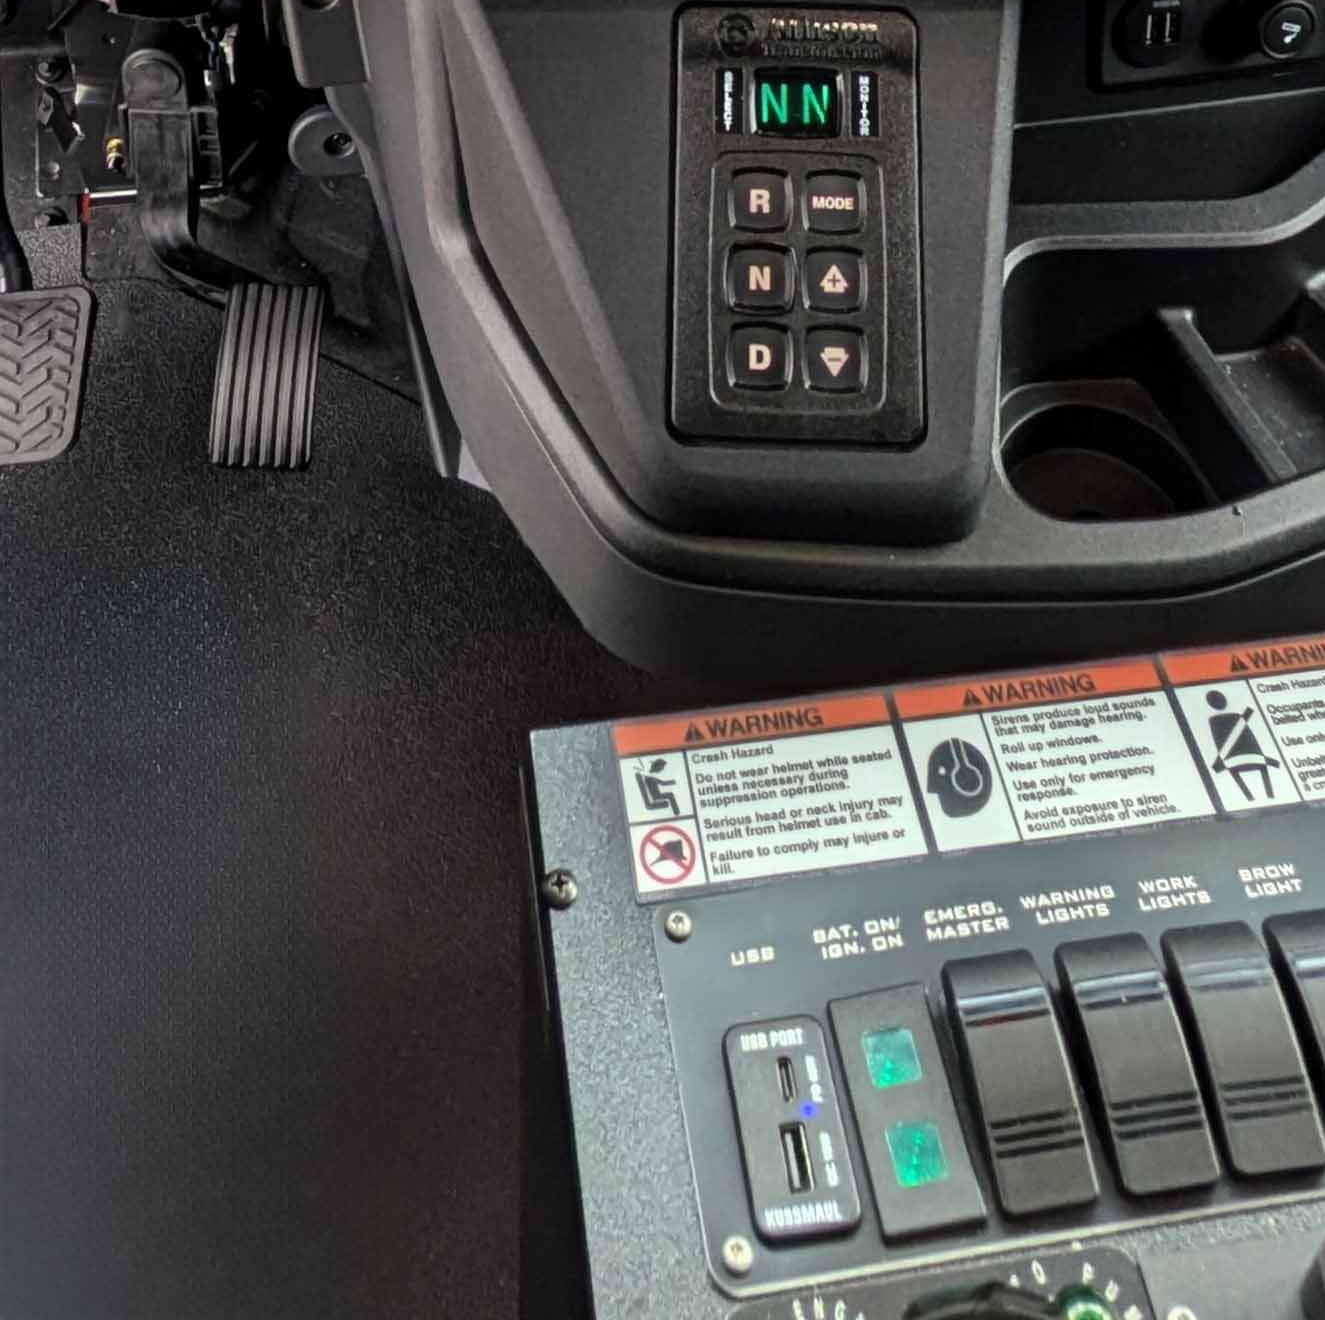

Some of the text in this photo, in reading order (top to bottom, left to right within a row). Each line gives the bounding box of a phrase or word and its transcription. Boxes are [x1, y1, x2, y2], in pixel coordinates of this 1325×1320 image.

[761, 83, 829, 124] N N
[859, 76, 870, 136] MONITOR
[750, 189, 771, 213] R
[812, 196, 854, 210] MODE
[749, 266, 771, 291] N
[748, 344, 771, 370] D
[982, 674, 1096, 706] WARNING
[706, 708, 823, 739] WARNING
[991, 697, 1155, 726] Sirens produce loud sounds
[1281, 734, 1304, 747] Use
[692, 744, 774, 765] Crash Hazard
[695, 749, 892, 784] Do not wear helmet while seated
[1006, 745, 1154, 773] Wear hearing protection.
[697, 769, 849, 796] unless necessary during
[1013, 764, 1155, 791] Use only for emergency
[703, 795, 903, 830] Serious head or neck injury may
[706, 809, 892, 842] result from helmet use in cab.
[710, 828, 906, 863] Failure to comply may injure or
[1137, 875, 1198, 894] WORK
[1237, 863, 1297, 882] BROW
[1019, 885, 1116, 910] WARNING
[1137, 890, 1212, 912] LIGHTS
[1244, 878, 1303, 899] LIGHT
[924, 901, 1003, 925] EMERG.
[1036, 903, 1111, 925] LIGHTS
[813, 916, 901, 944] BAT. ON/
[926, 916, 1010, 942] MASTER
[730, 946, 775, 967] USB
[821, 933, 904, 960] IGN. ON
[740, 1028, 804, 1052] USB PORT
